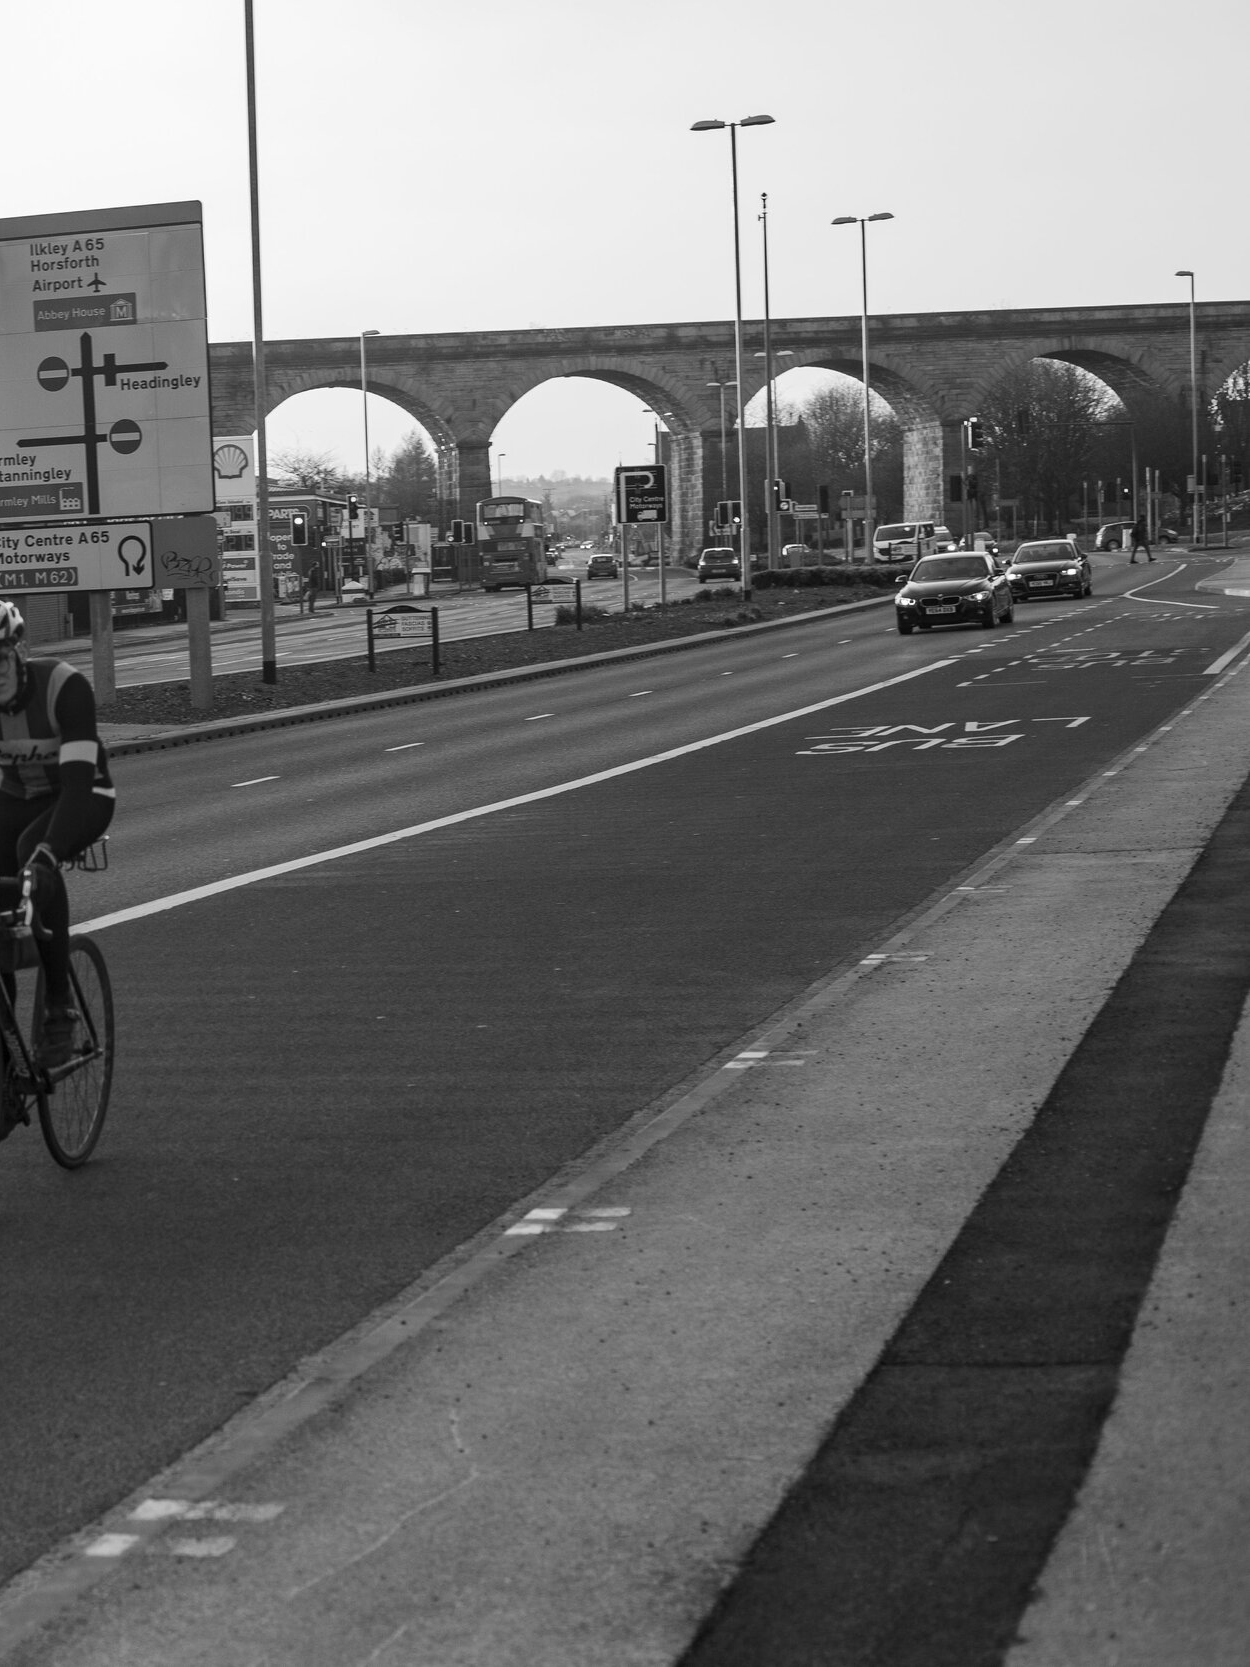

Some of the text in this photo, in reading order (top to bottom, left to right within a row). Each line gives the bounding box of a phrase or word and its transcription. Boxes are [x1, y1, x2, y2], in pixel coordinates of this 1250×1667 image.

[30, 243, 68, 256] Ilkley
[31, 255, 100, 273] Horsforth
[32, 276, 83, 293] Airport
[37, 306, 106, 322] Abbey House
[120, 374, 201, 391] Headingley
[31, 494, 57, 505] Mills
[25, 533, 74, 548] Centre
[272, 552, 294, 560] rade
[804, 716, 1092, 740] LANE
[795, 734, 1026, 754] BUS
